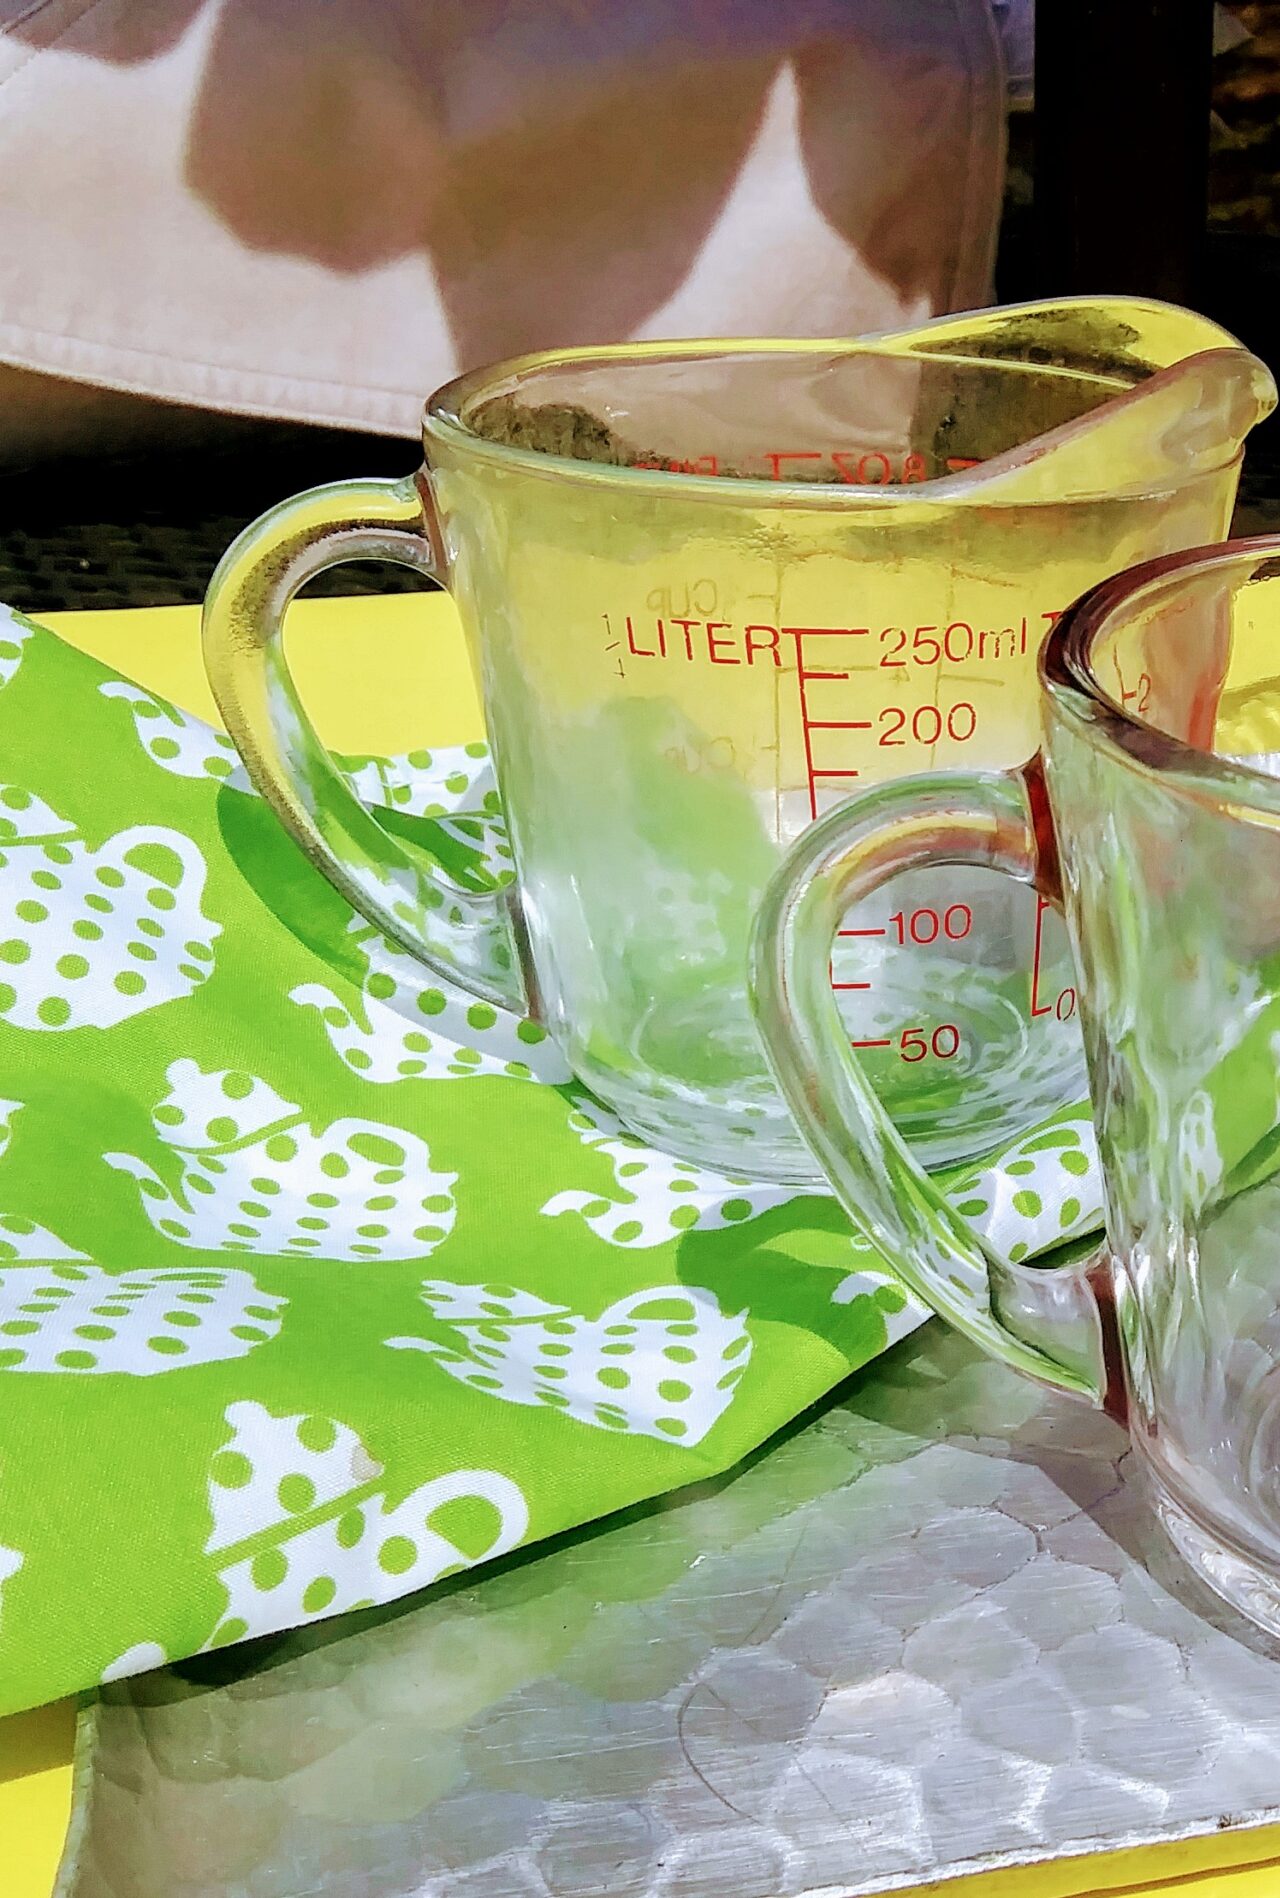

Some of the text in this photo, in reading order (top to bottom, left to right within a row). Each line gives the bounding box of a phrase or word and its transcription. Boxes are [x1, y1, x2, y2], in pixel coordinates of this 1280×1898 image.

[626, 616, 783, 667] LITER
[879, 617, 1028, 668] 250ml
[877, 702, 977, 746] 200
[889, 904, 972, 945] 100
[900, 1024, 960, 1063] 50
